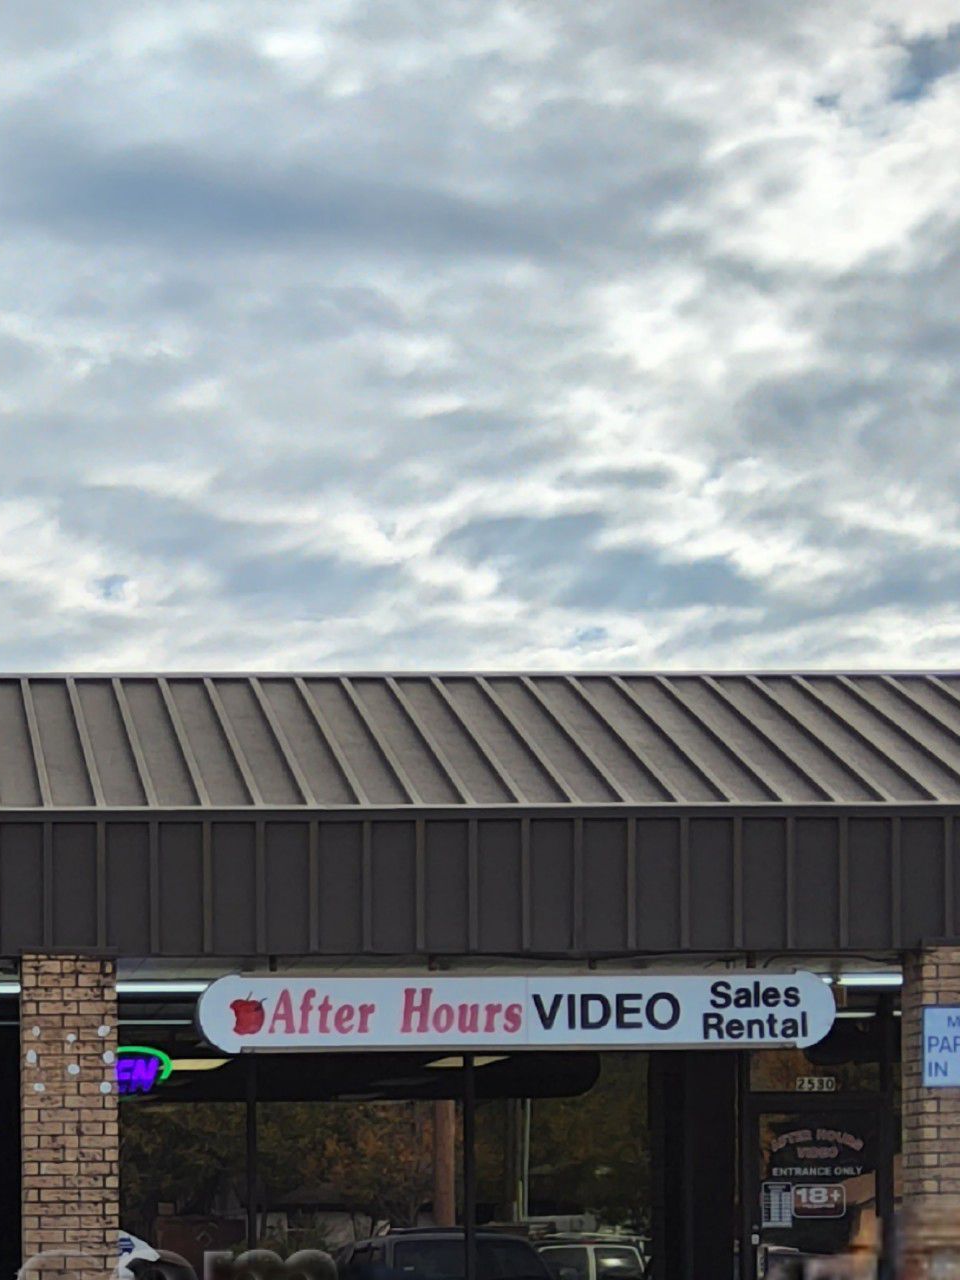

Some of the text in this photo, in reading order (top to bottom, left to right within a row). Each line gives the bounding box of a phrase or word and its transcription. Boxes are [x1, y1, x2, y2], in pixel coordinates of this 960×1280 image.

[709, 980, 801, 1010] Sales
[267, 987, 681, 1035] After Hours VIDEO
[702, 1010, 809, 1040] Rental
[115, 1056, 159, 1093] EN
[772, 1165, 864, 1177] ENTRANCE ONLY
[795, 1187, 841, 1203] 18+
